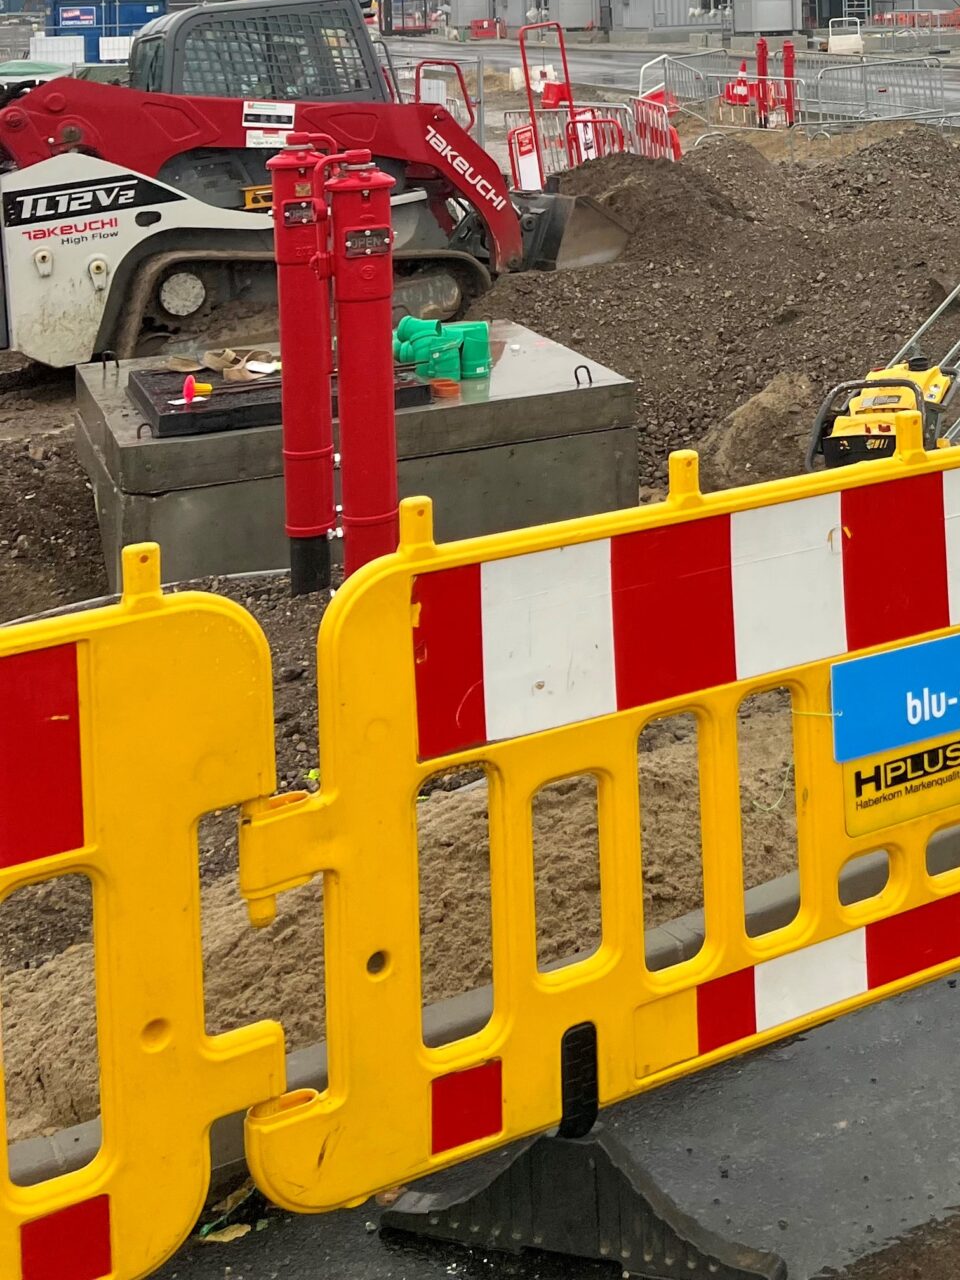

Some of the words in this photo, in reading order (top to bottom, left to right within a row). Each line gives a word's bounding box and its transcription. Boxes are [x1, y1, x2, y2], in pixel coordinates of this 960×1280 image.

[16, 179, 138, 219] TL12V2
[61, 235, 88, 246] High
[92, 231, 119, 241] Flow
[350, 236, 382, 249] OPEN
[855, 789, 902, 812] Haberkorn
